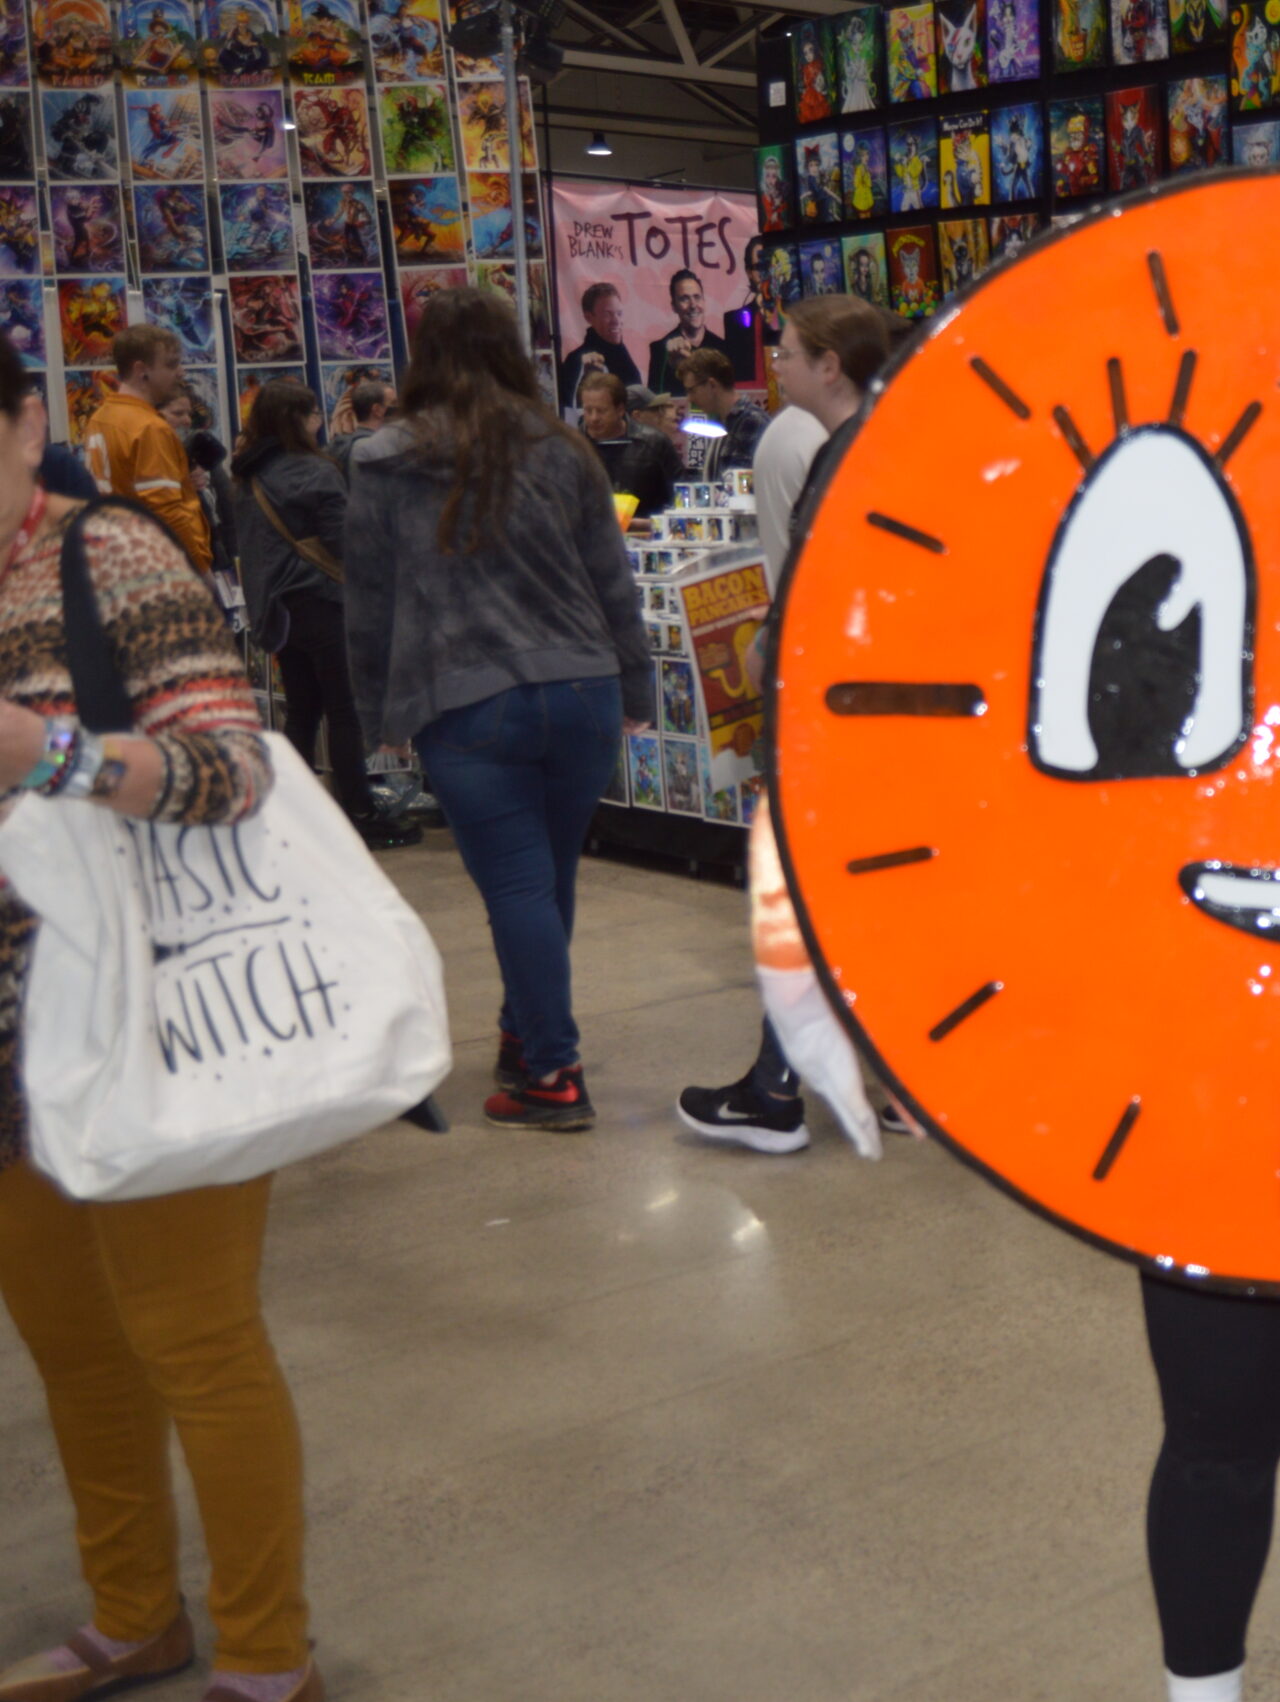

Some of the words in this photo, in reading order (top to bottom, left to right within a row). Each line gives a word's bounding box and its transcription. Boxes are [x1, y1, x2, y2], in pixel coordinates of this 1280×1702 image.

[573, 220, 614, 238] DREW
[611, 211, 736, 275] TOTES
[683, 565, 764, 610] BACON
[155, 940, 339, 1074] WITCH
